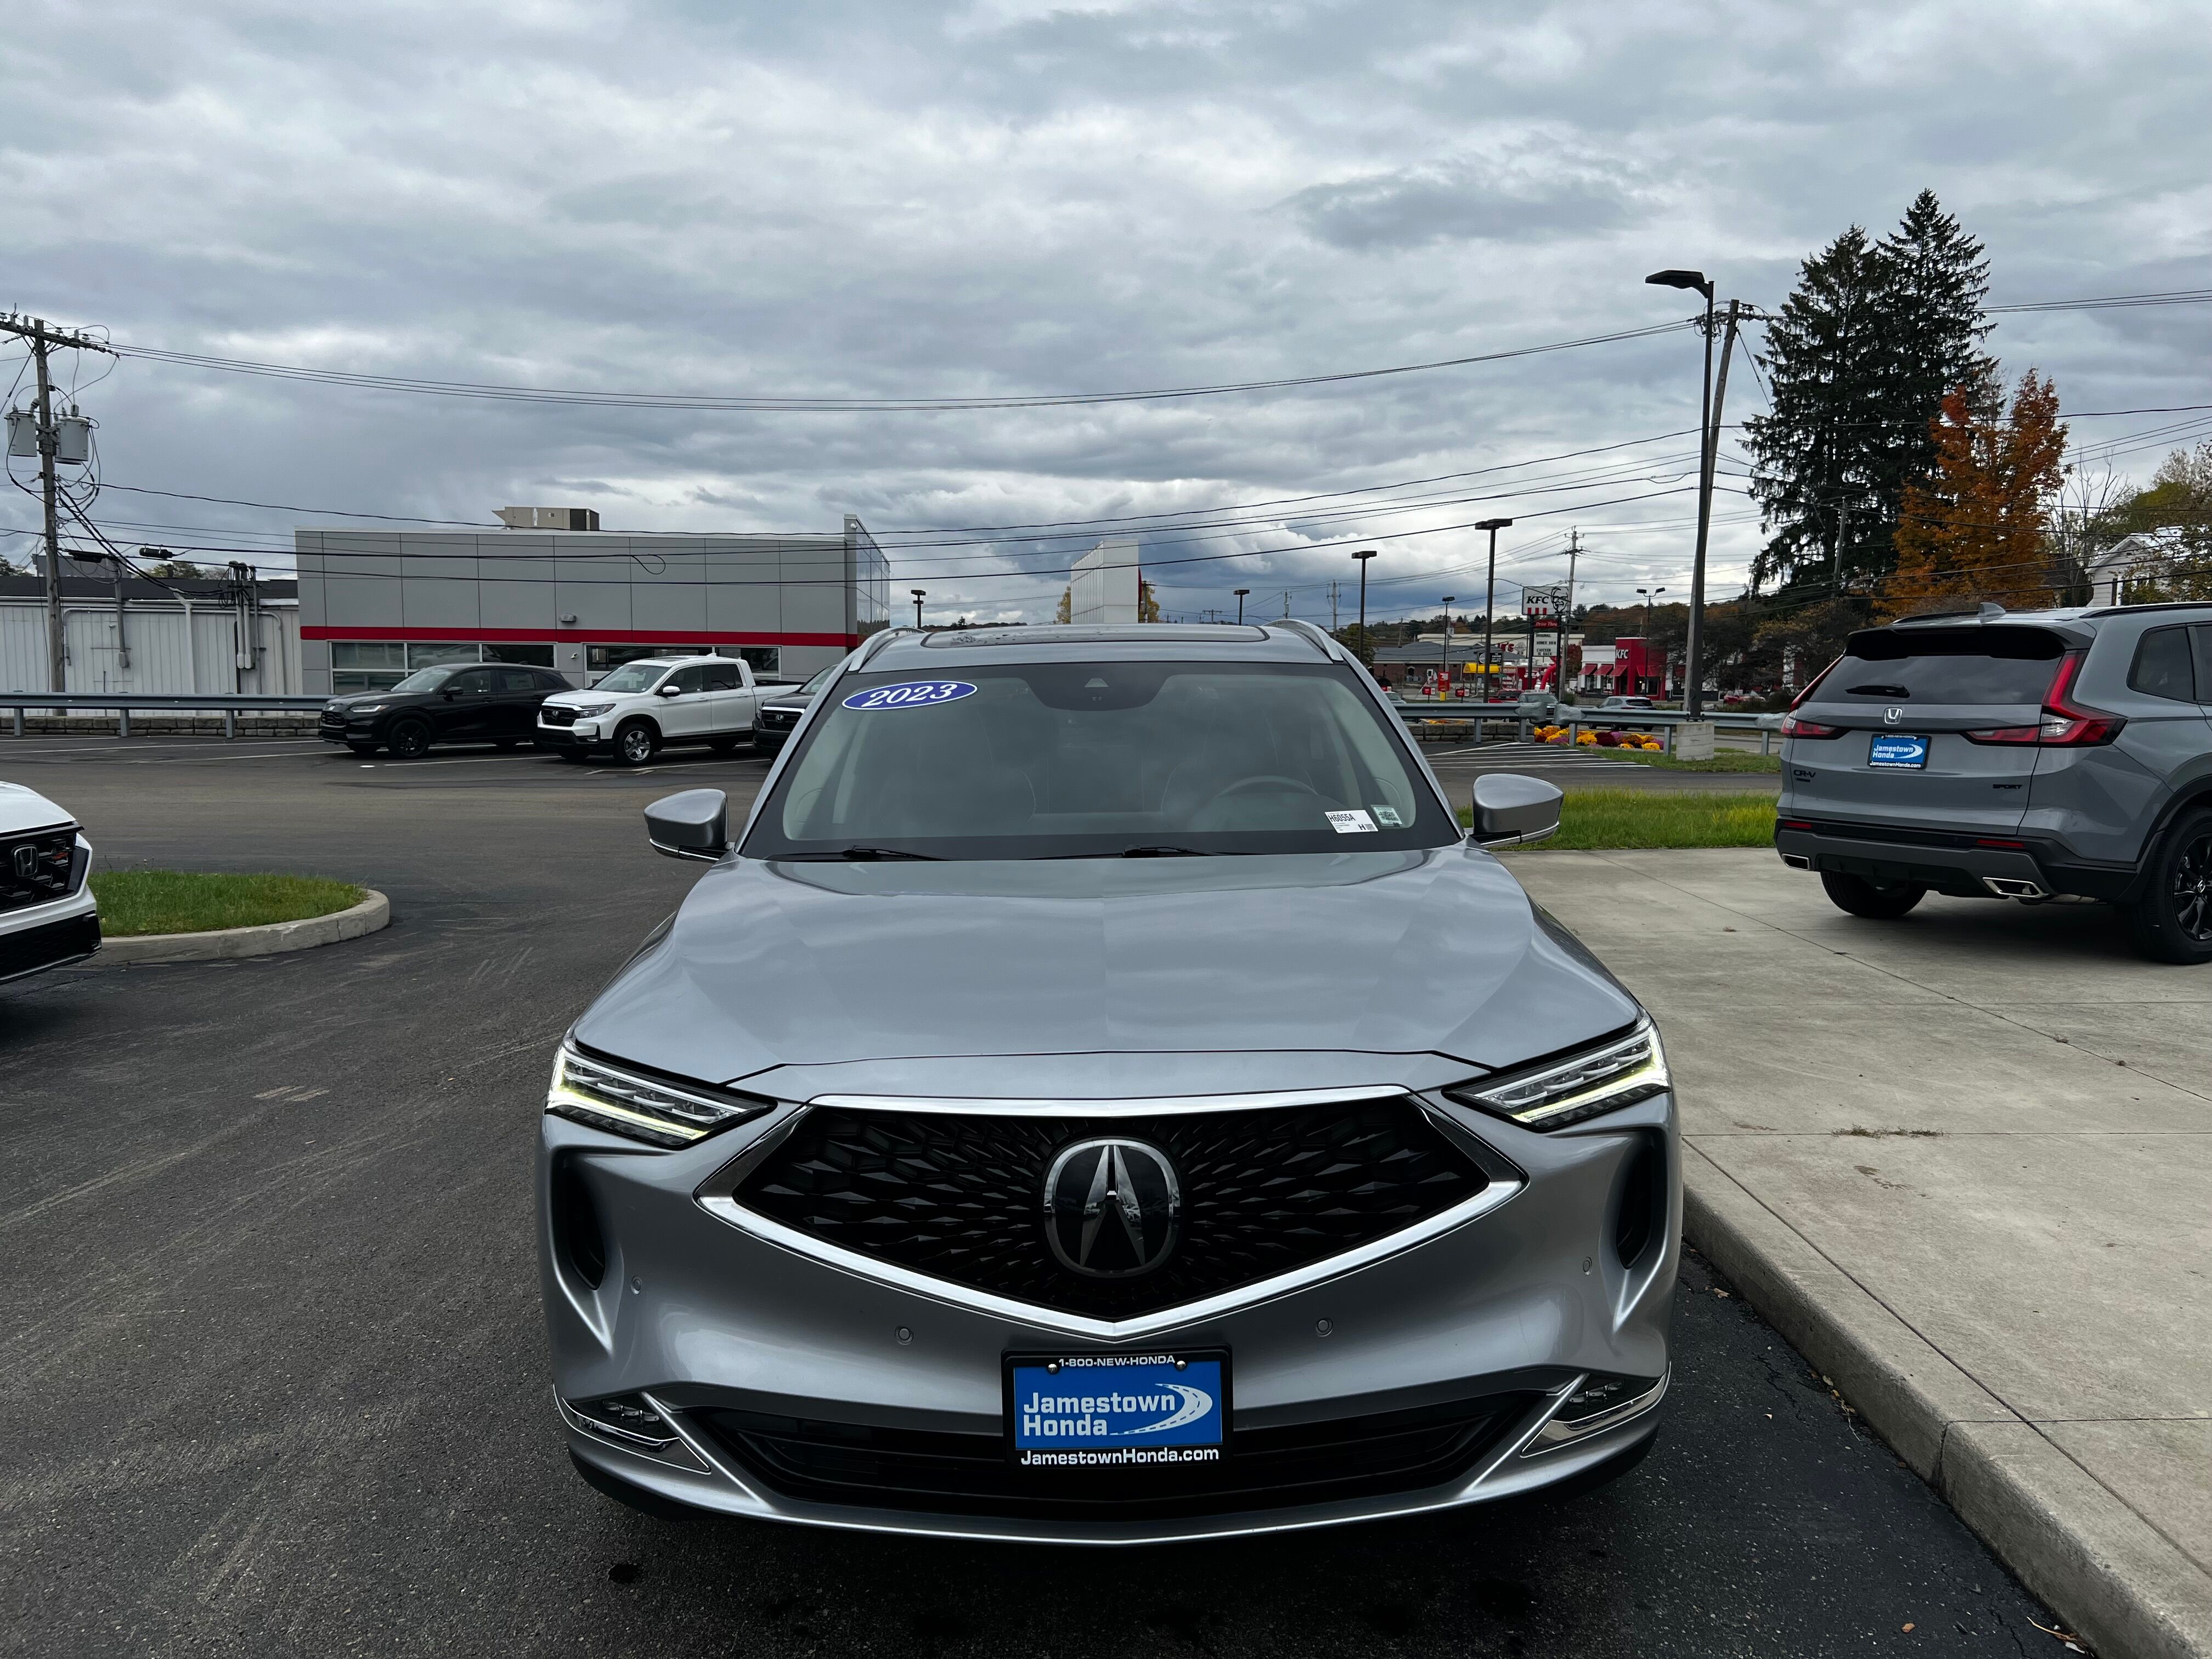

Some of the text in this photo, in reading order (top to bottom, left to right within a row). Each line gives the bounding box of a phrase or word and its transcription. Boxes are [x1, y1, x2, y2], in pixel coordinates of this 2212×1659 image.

[1526, 596, 1549, 604] KFC
[1615, 649, 1629, 659] KFC
[861, 684, 958, 707] 2023
[1328, 813, 1356, 822] H6055A
[1059, 1355, 1176, 1367] 1-800-NEW-HONDA
[1024, 1392, 1175, 1414] Jamestown
[1024, 1414, 1107, 1436] Honda
[1021, 1447, 1219, 1465] JamestownHonda.com
